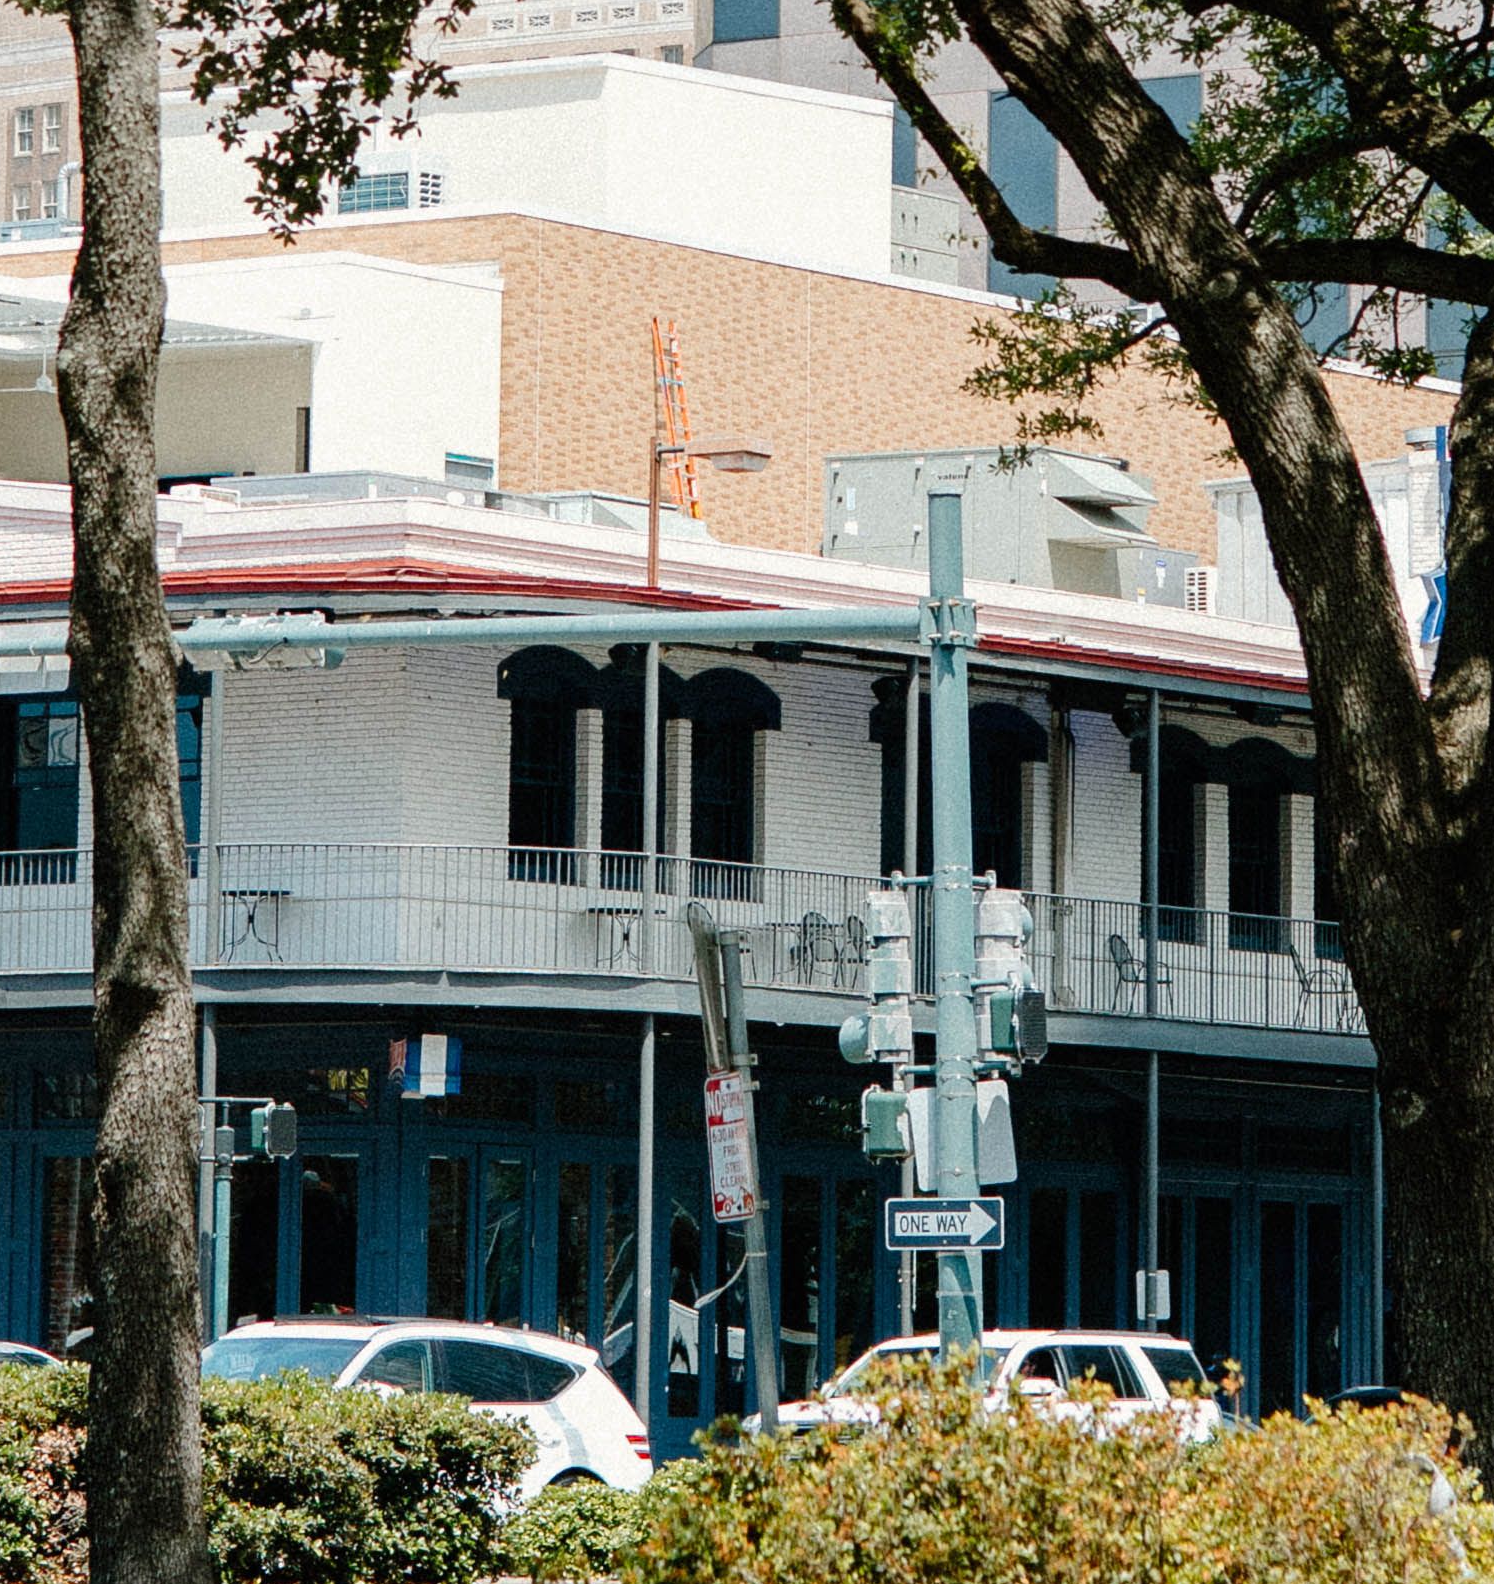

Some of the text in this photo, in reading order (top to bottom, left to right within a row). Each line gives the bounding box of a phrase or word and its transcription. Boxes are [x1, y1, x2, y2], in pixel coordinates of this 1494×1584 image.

[706, 1089, 723, 1117] NO
[899, 1214, 967, 1233] ONE WAY
